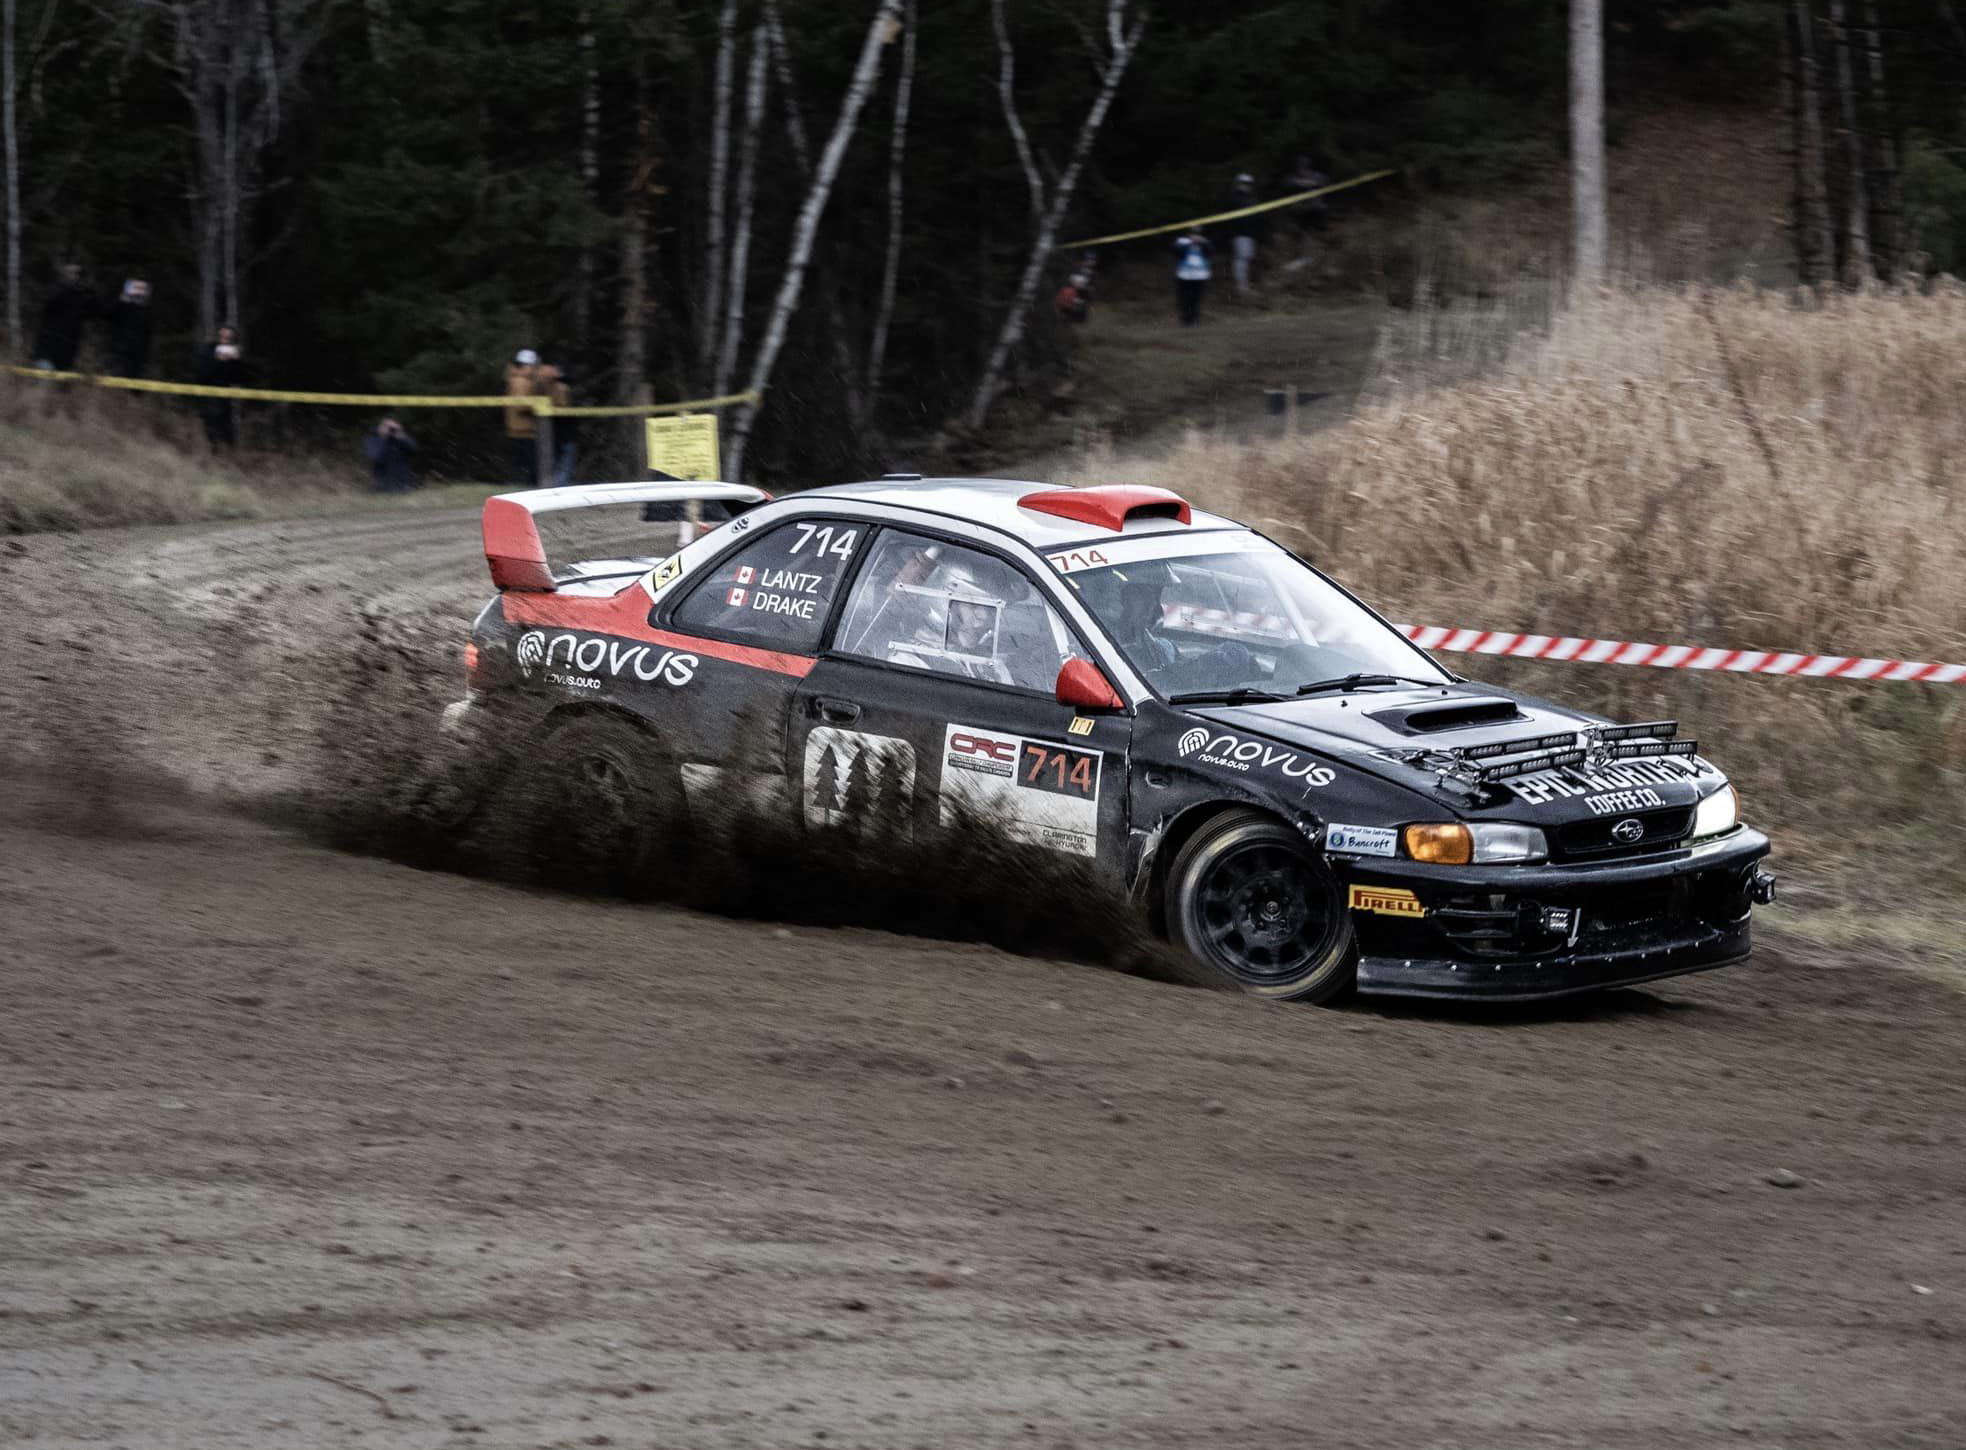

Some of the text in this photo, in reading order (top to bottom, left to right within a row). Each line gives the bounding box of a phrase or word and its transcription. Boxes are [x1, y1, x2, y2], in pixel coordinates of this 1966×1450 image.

[789, 523, 858, 561] 714
[1050, 550, 1108, 571] 714
[761, 568, 822, 594] LANTZ
[752, 592, 817, 619] DRAKE
[950, 732, 1016, 762] CRC
[1026, 745, 1092, 793] 714
[1502, 768, 1587, 806] EPIC
[1584, 792, 1642, 815] COFFEE
[1348, 836, 1390, 849] Bancroft
